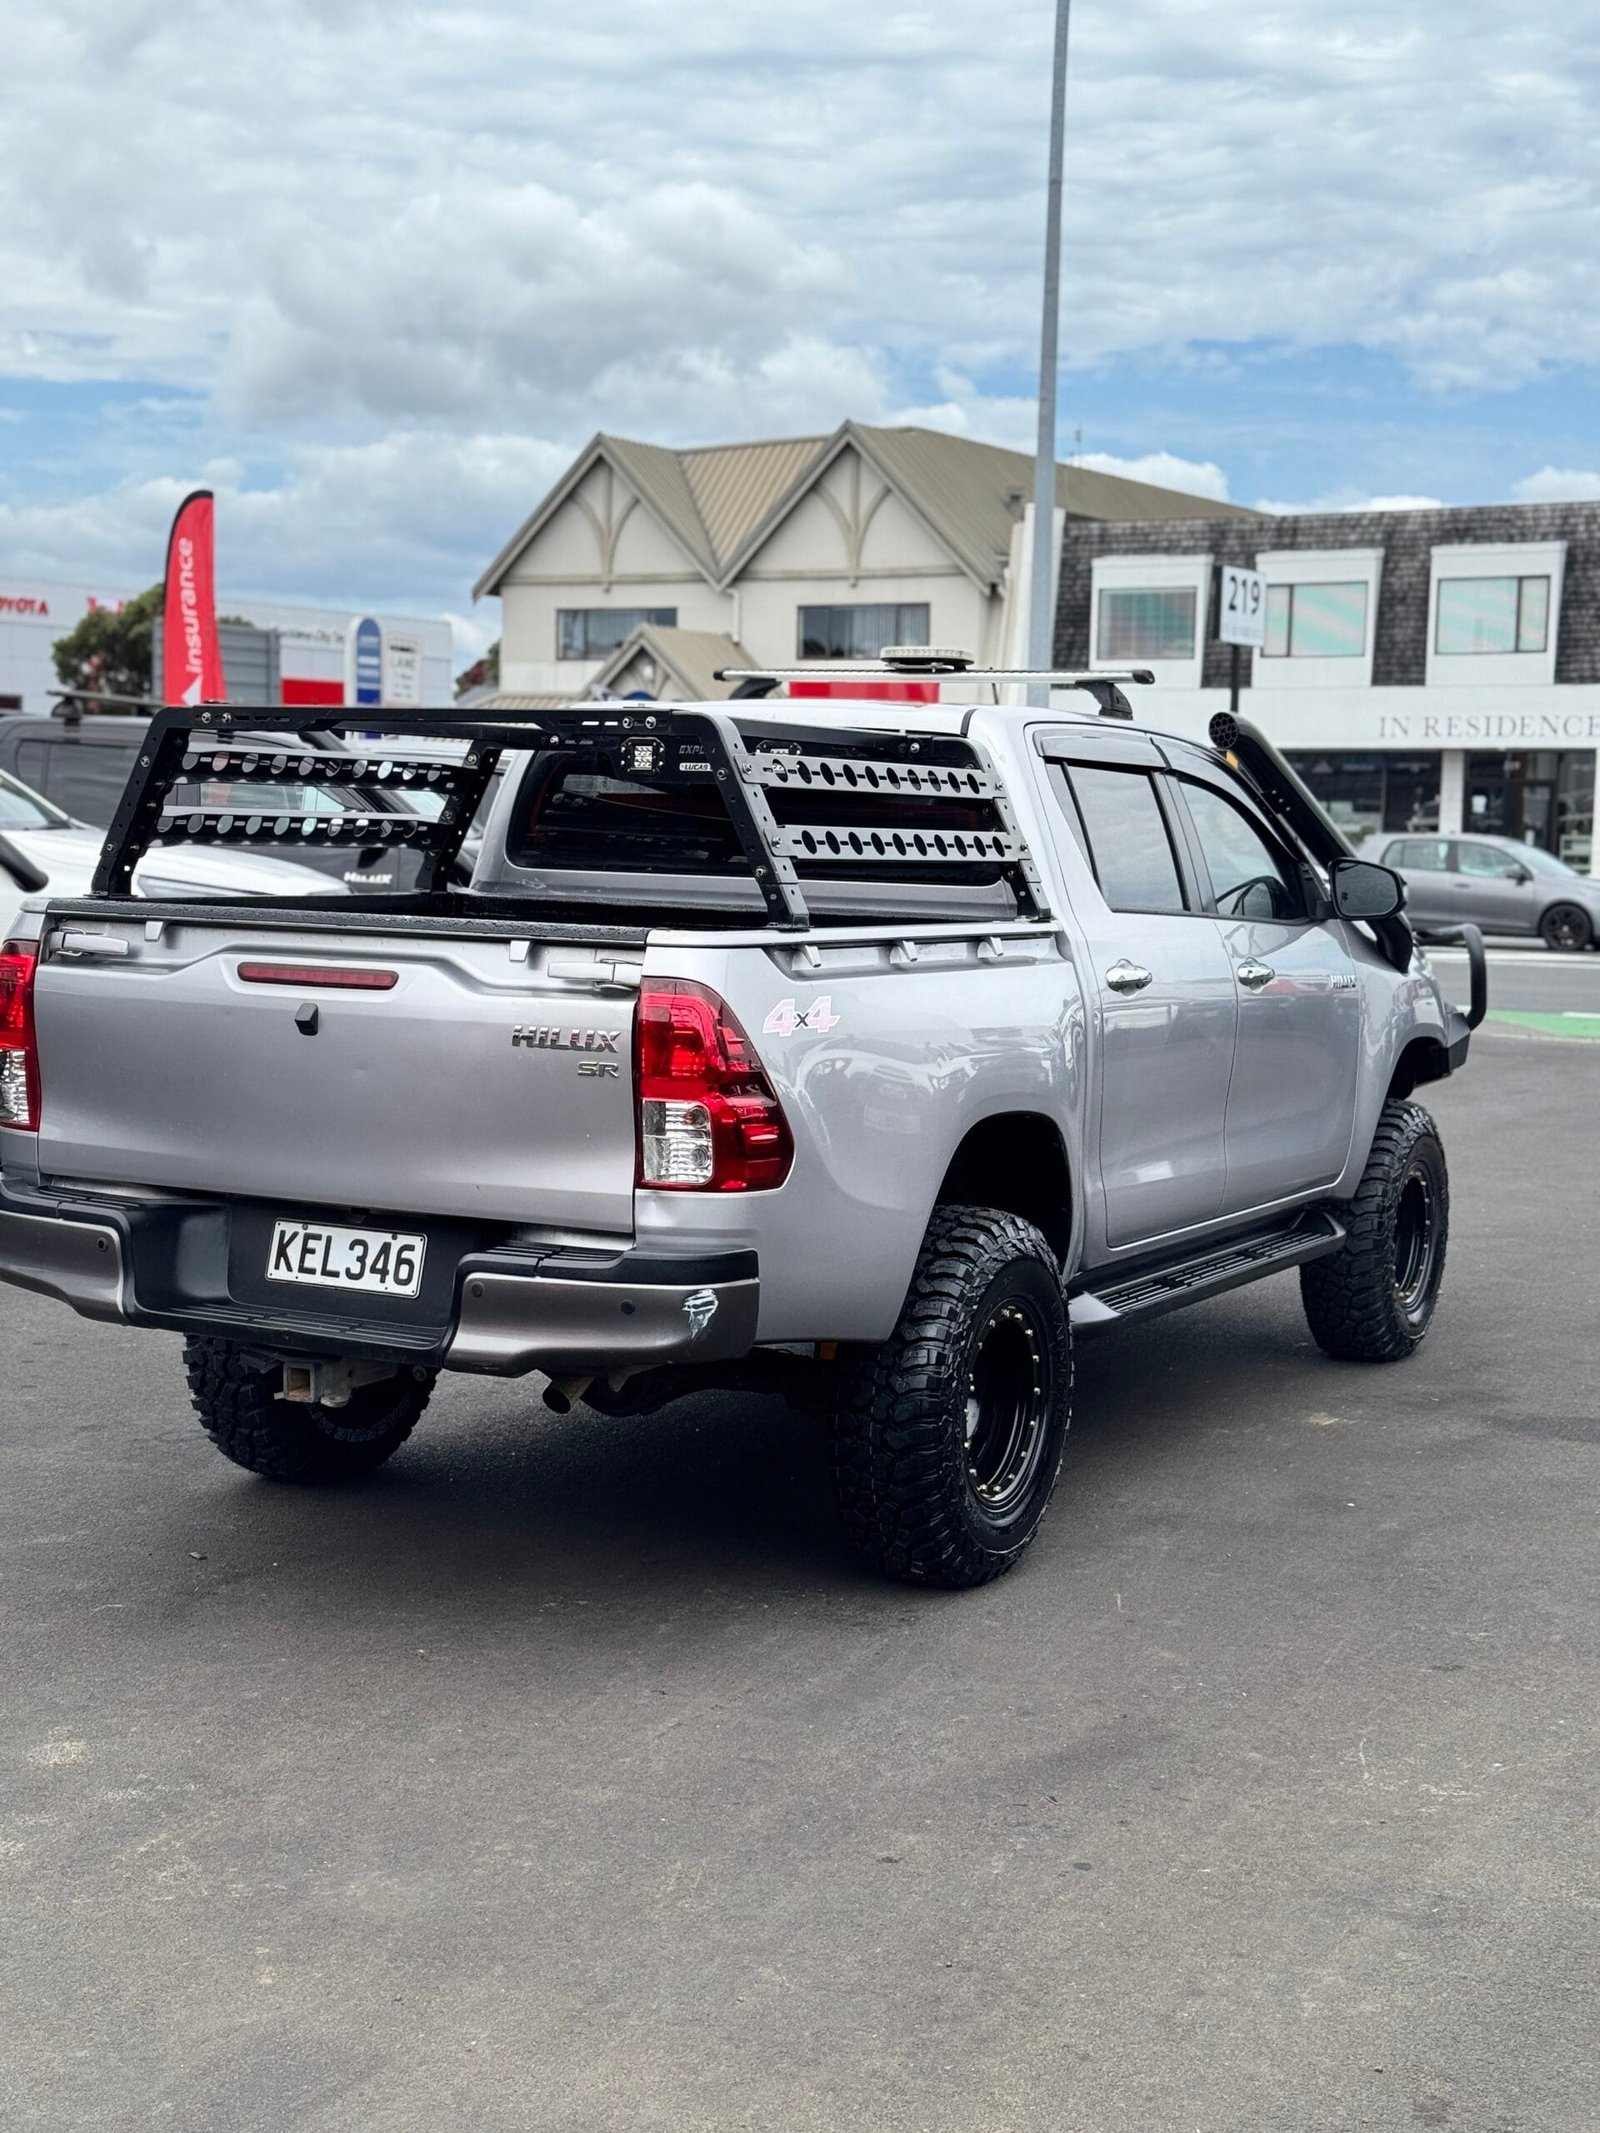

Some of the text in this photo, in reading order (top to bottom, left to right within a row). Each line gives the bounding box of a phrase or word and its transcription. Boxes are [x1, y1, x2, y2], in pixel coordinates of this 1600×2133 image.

[1229, 576, 1260, 615] 219
[1379, 715, 1600, 738] IN RESIDENCE
[512, 1025, 621, 1053] HILUX
[577, 1062, 619, 1078] SR
[274, 1229, 416, 1287] KEL346
